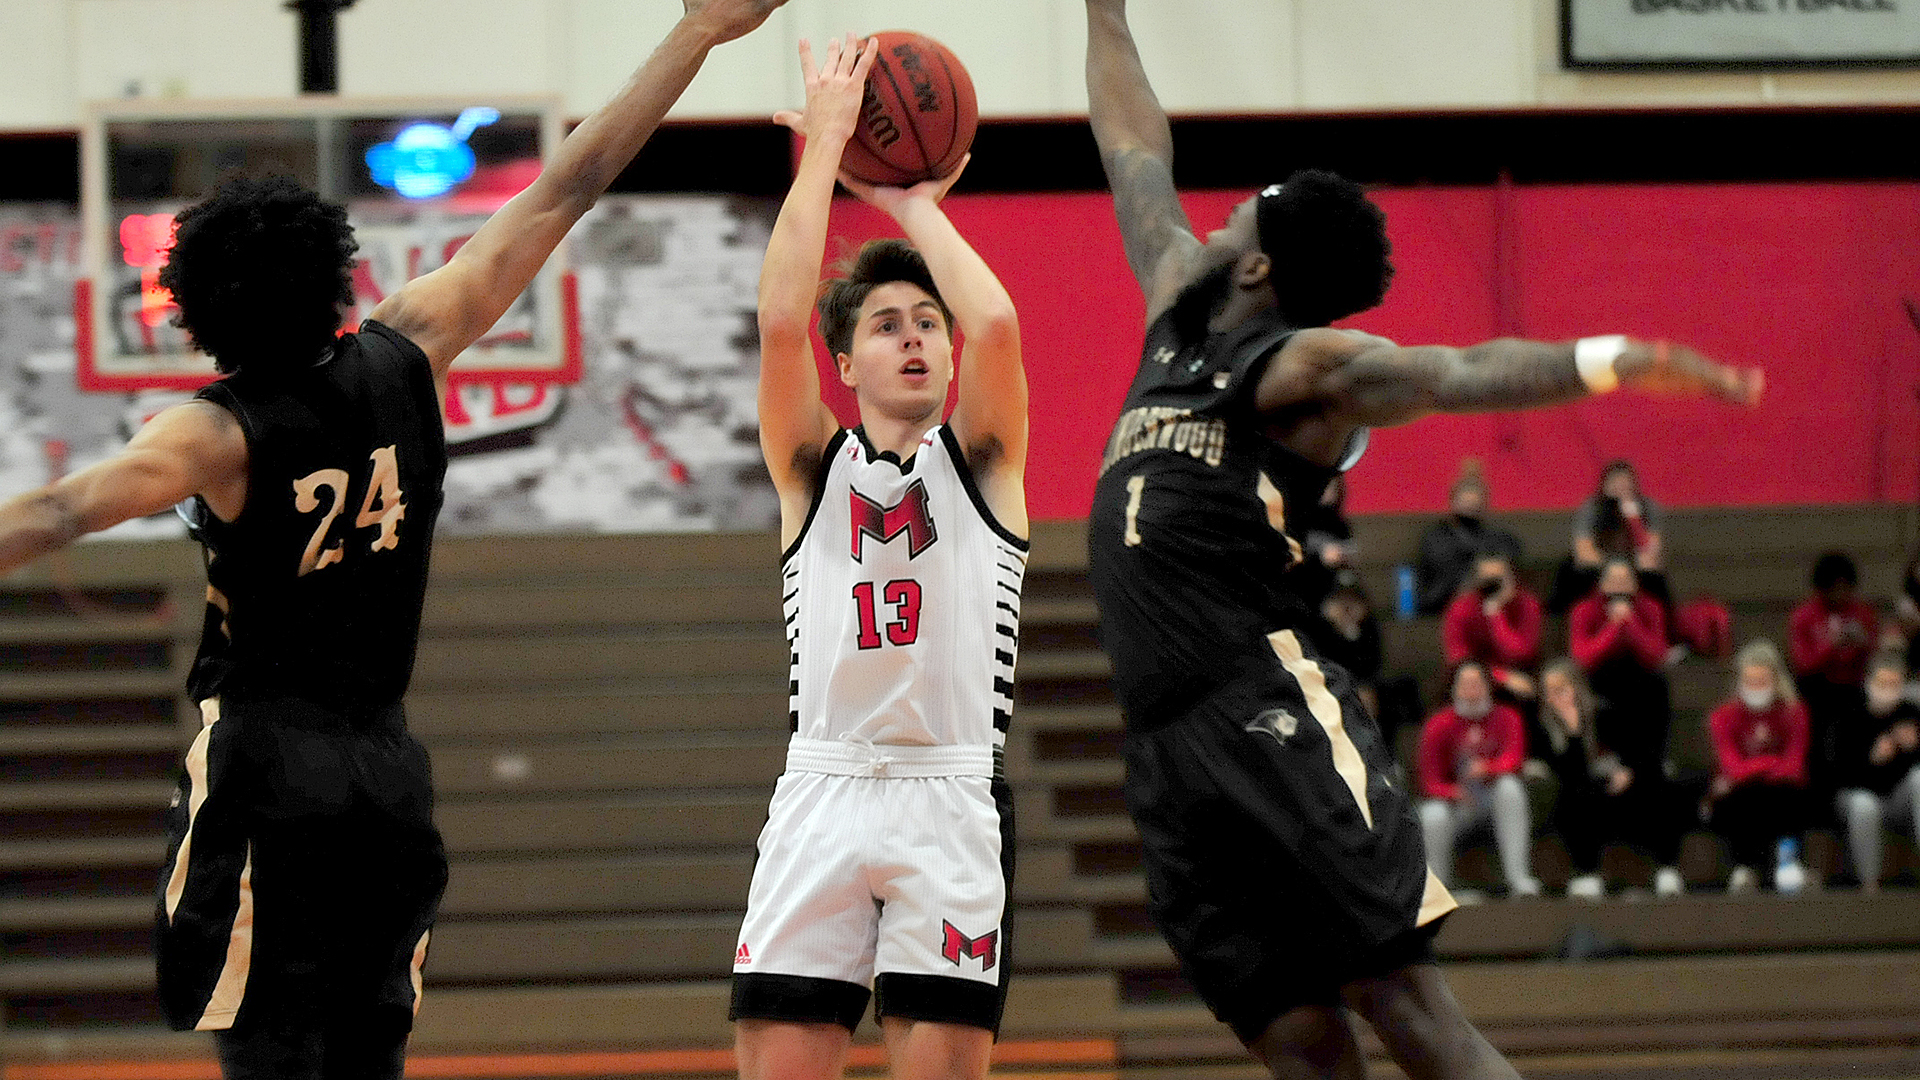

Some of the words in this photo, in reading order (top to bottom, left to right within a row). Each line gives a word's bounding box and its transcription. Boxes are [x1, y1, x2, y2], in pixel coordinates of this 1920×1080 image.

[292, 444, 408, 577] 24
[850, 476, 938, 565] M
[1124, 475, 1145, 547] 1
[852, 578, 923, 651] 13
[941, 917, 999, 972] M
